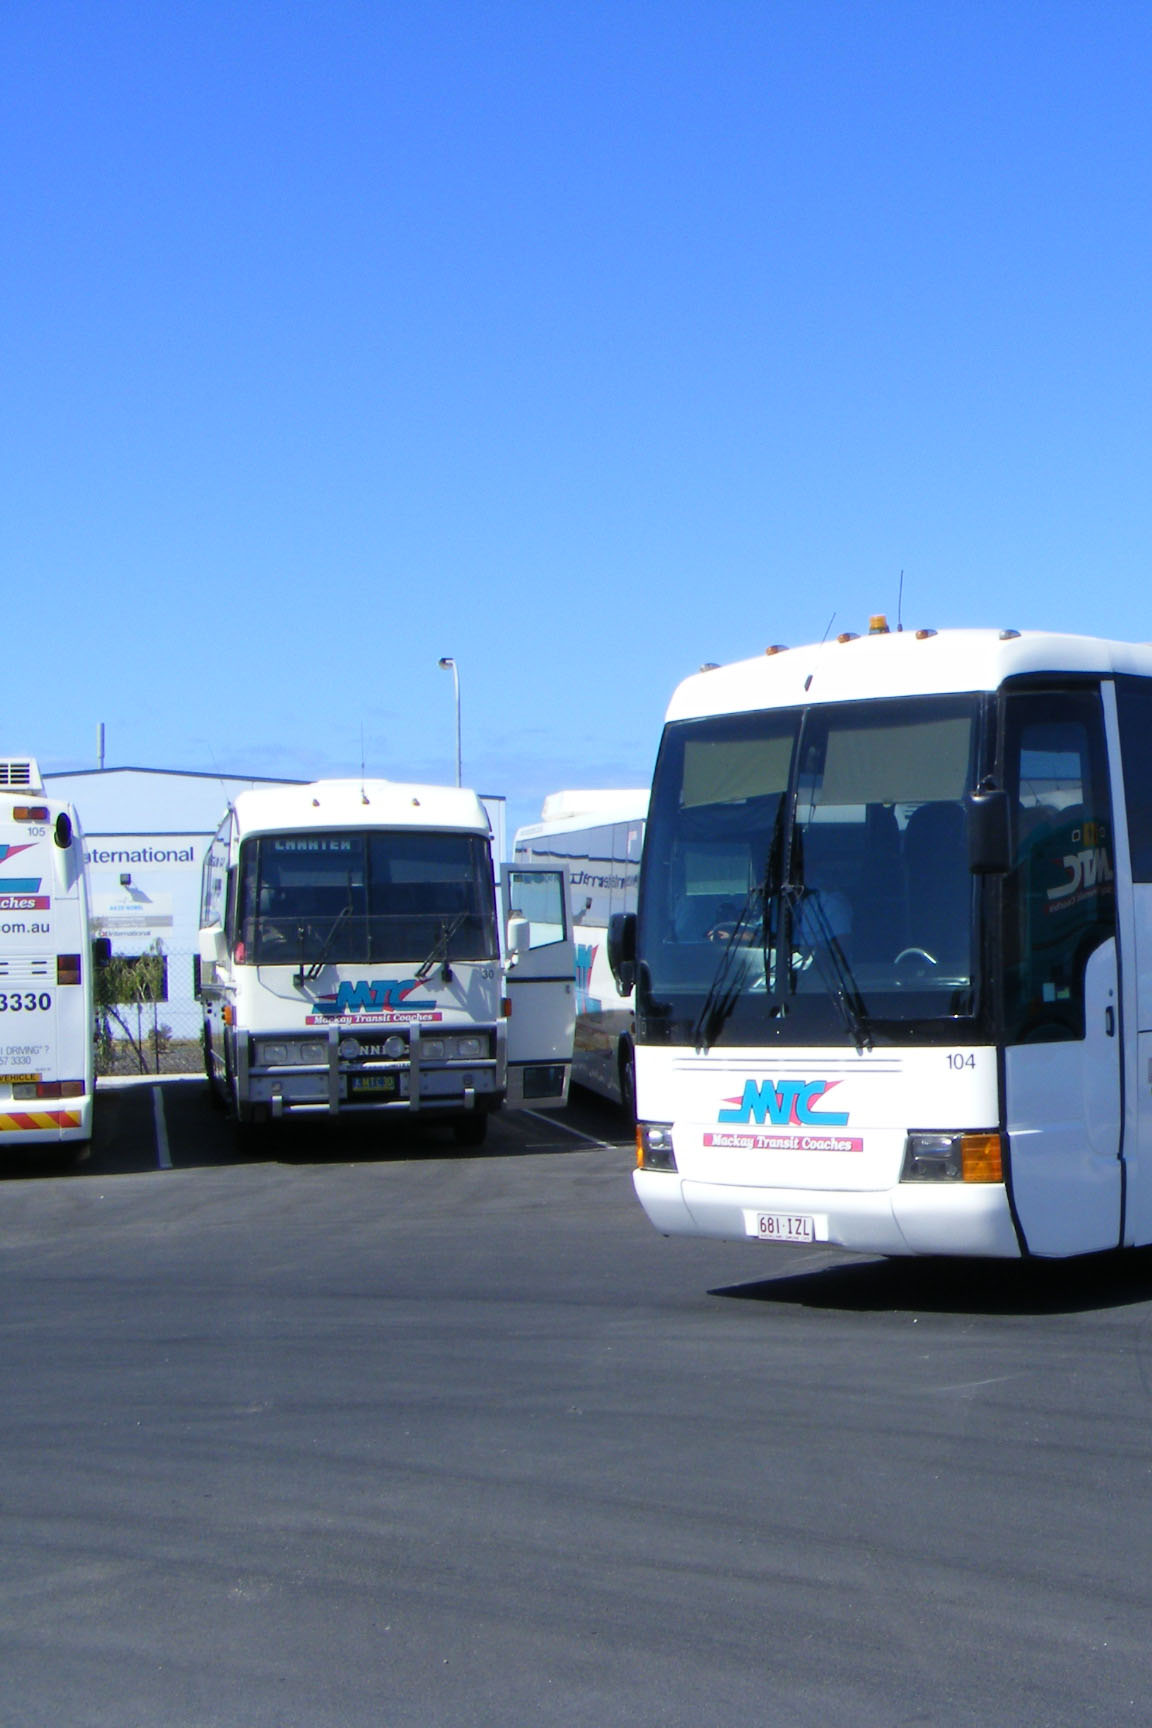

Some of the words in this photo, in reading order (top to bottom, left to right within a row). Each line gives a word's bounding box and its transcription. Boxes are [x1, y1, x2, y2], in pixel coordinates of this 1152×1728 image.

[27, 827, 46, 837] 105
[0, 922, 50, 933] om.au
[482, 969, 495, 980] 30
[311, 980, 437, 1014] MTC
[314, 1015, 352, 1025] Mackay
[355, 1013, 391, 1024] Transit
[393, 1012, 433, 1022] Coaches
[11, 1056, 32, 1065] 3330
[946, 1053, 976, 1070] 104
[718, 1079, 850, 1127] MTC
[712, 1133, 754, 1150] Mackay
[756, 1136, 800, 1150] Transit
[801, 1139, 852, 1151] Coaches
